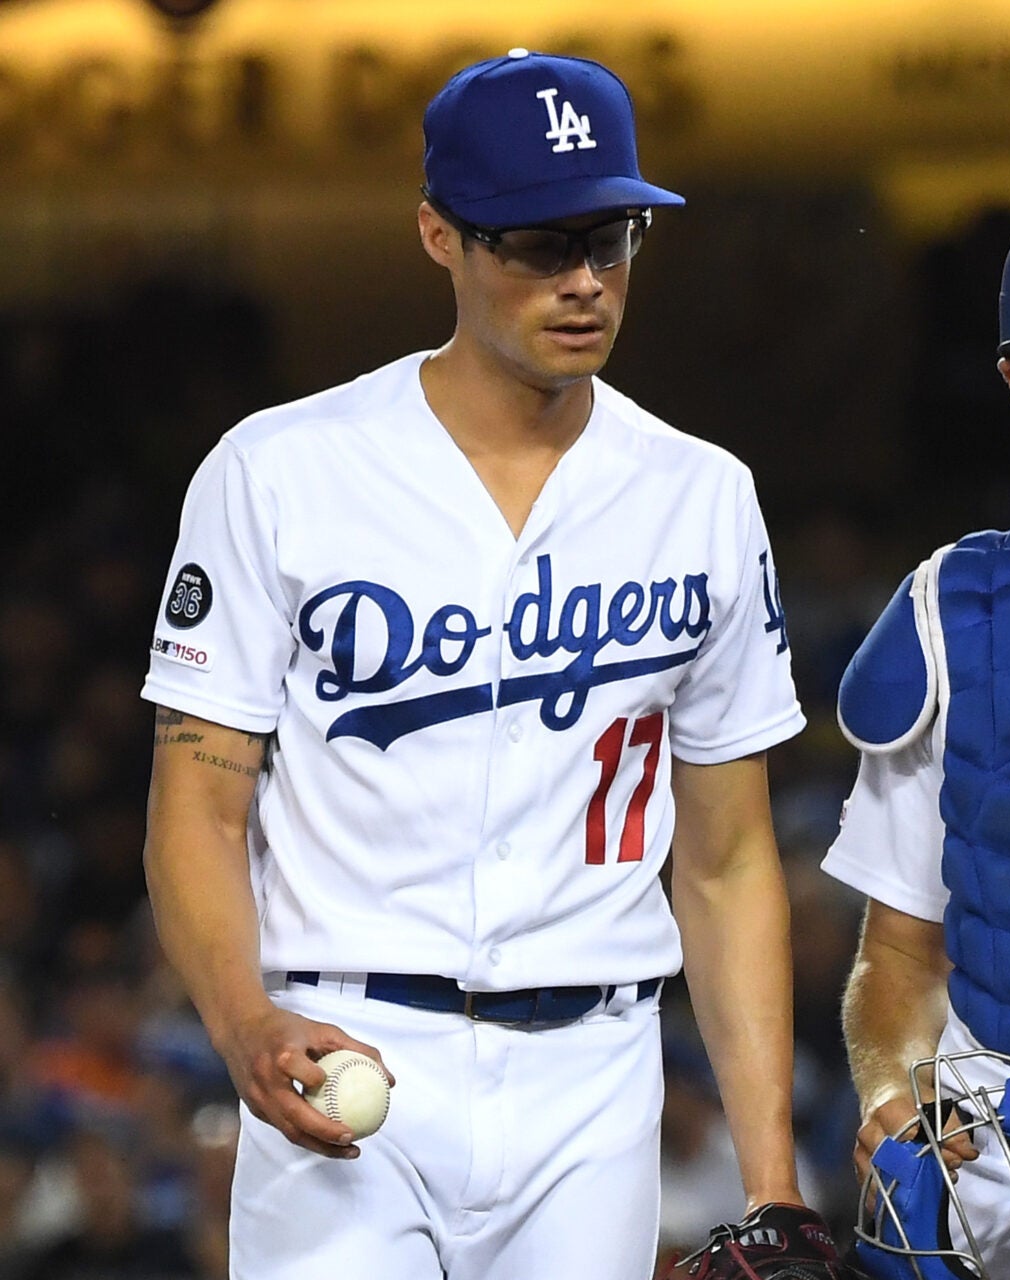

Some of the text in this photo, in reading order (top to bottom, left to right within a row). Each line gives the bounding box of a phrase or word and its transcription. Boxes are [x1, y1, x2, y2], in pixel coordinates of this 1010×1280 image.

[537, 88, 597, 153] LA
[170, 582, 203, 618] 36
[179, 645, 208, 665] 150
[299, 553, 713, 732] Dodgers
[586, 716, 664, 866] 17
